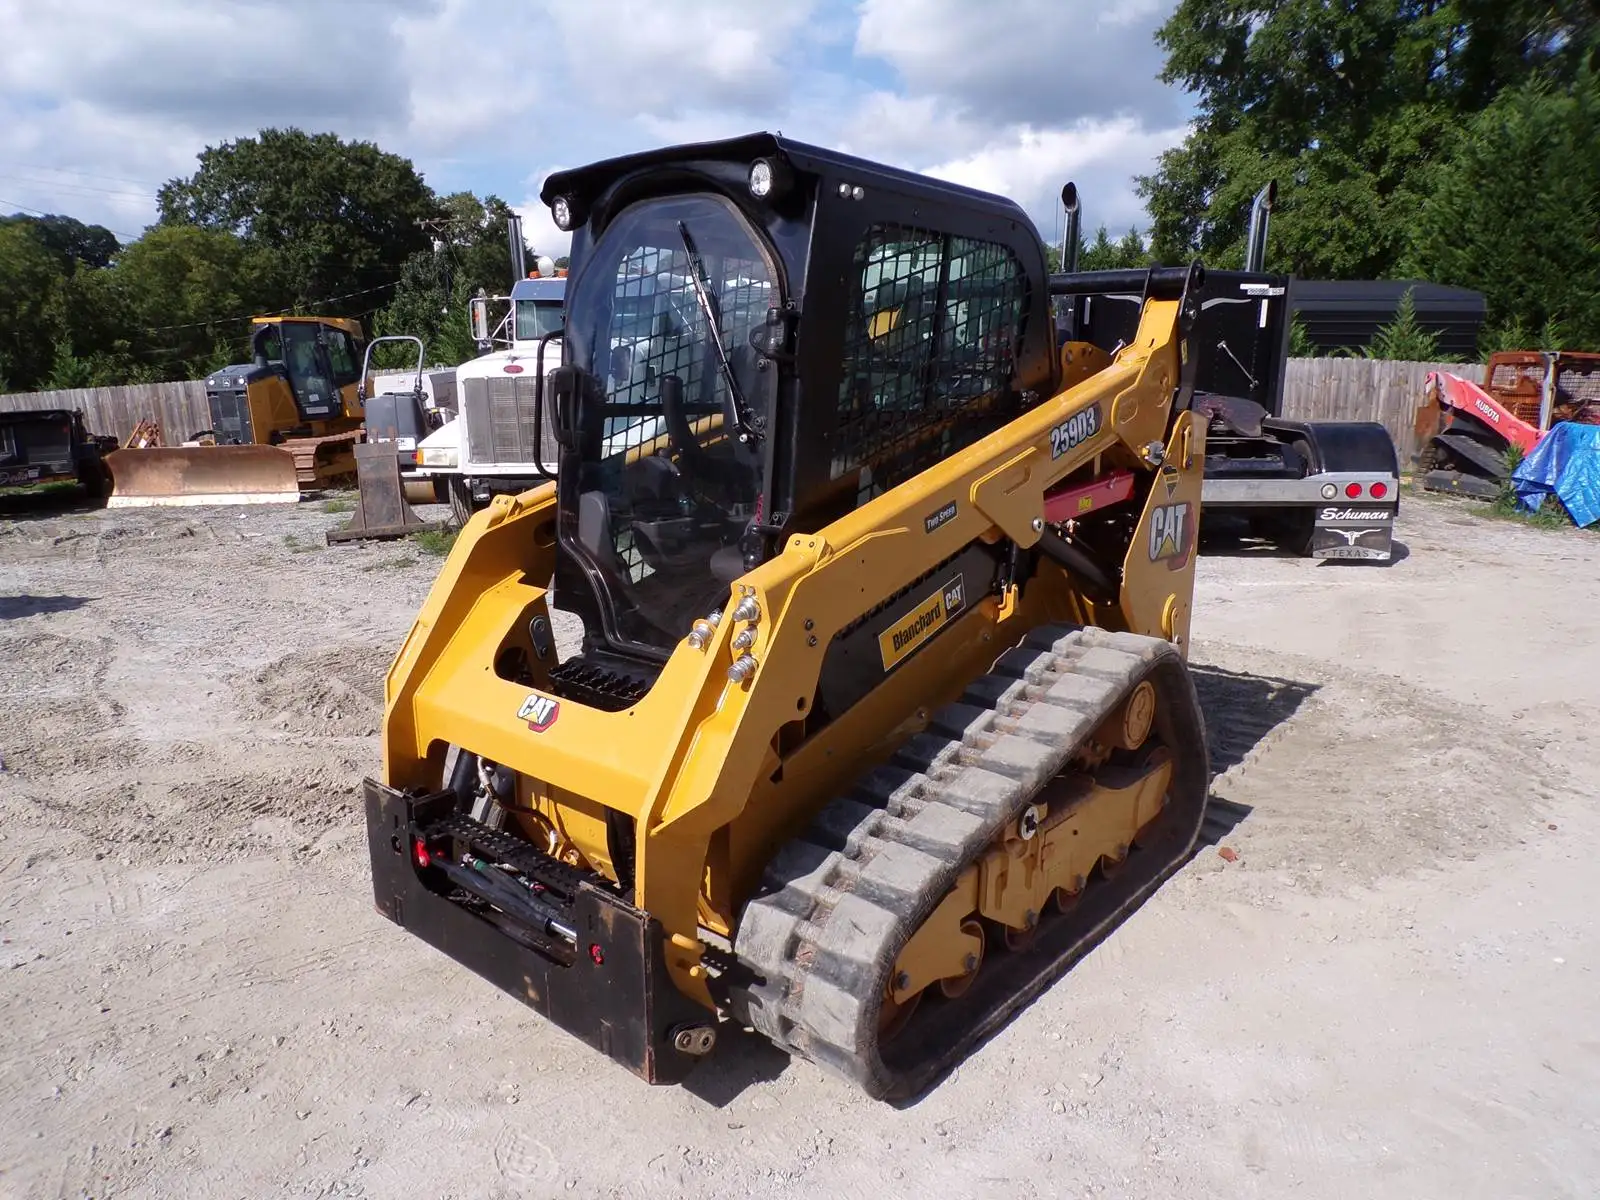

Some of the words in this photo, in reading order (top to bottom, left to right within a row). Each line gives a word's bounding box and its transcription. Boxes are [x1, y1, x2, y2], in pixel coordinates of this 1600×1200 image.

[1474, 398, 1500, 424] KUBOTA
[1051, 407, 1096, 459] 259D3
[1320, 507, 1389, 521] Schuman
[1149, 503, 1187, 561] CAT
[1332, 548, 1369, 558] TEXAS
[892, 601, 942, 653] Blanchard
[945, 584, 962, 611] CAT
[517, 694, 557, 725] CAT
